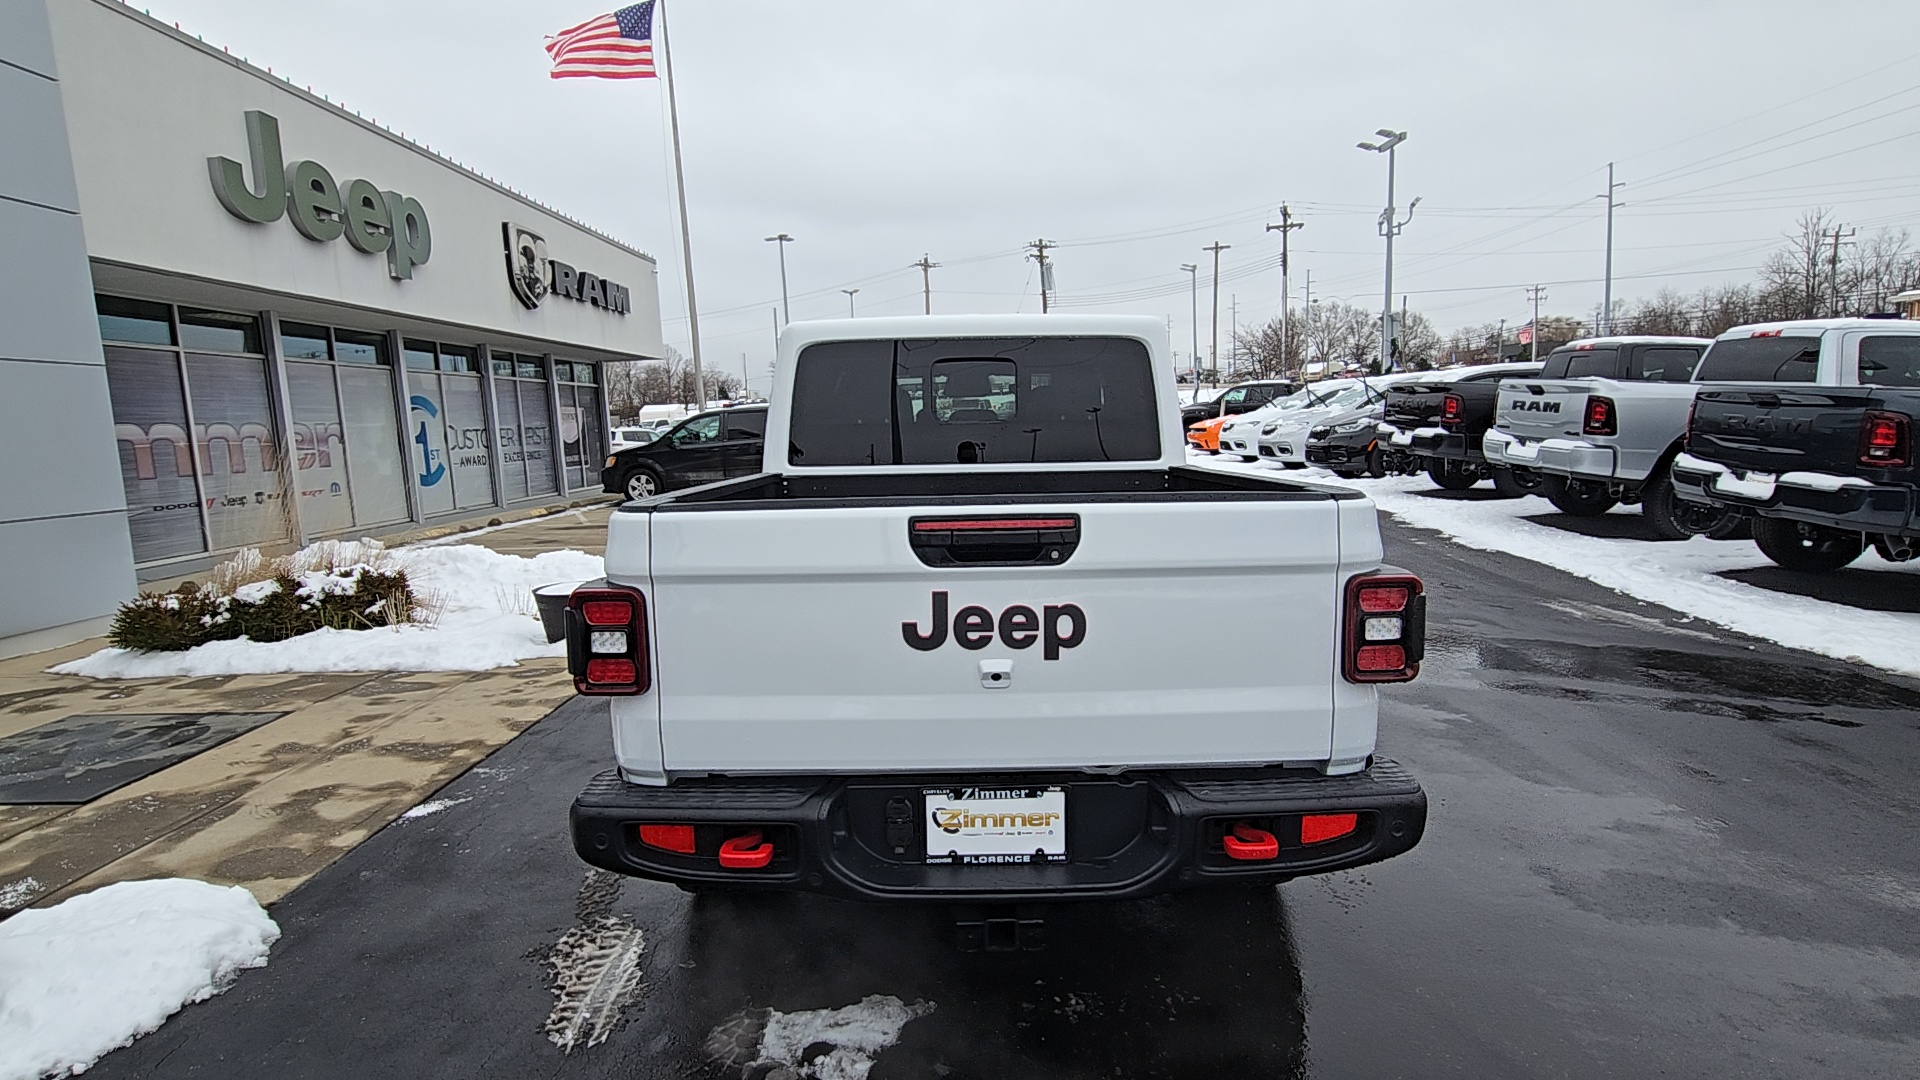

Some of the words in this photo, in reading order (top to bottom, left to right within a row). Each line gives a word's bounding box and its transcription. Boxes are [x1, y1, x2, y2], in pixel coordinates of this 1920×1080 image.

[207, 110, 431, 280] Jeep
[549, 260, 631, 314] RAM
[1511, 400, 1561, 413] RAM
[1723, 412, 1814, 432] RAM
[460, 455, 487, 467] AWARD
[153, 502, 199, 511] DODG
[901, 590, 1086, 661] Jeep
[961, 788, 1029, 800] Zimmer
[940, 808, 1060, 828] Zimmer
[963, 855, 1031, 864] FLORENCE
